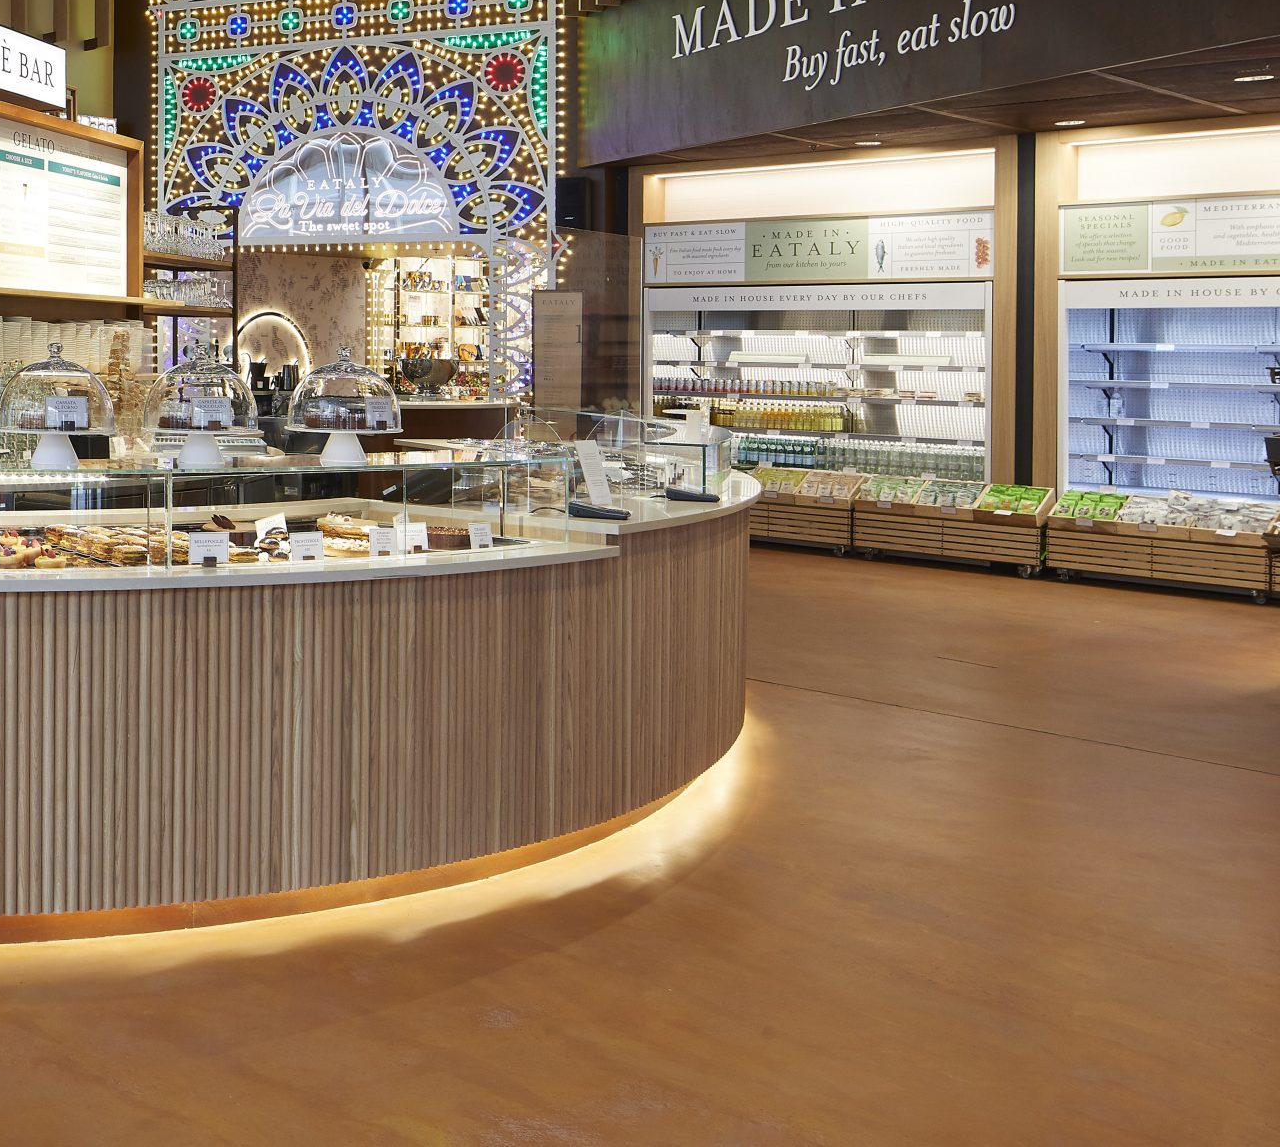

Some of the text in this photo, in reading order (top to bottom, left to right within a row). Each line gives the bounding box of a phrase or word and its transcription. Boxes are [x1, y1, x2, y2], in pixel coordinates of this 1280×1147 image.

[782, 44, 828, 90] Buy
[830, 29, 887, 87] fast,
[896, 13, 941, 55] eat
[18, 51, 55, 88] BAR
[13, 131, 55, 155] GELATO
[306, 177, 383, 191] EATALY
[252, 189, 443, 229] La Via del Dolce
[956, 216, 984, 224] FOOD
[1078, 213, 1136, 223] SEASONAL
[298, 220, 391, 234] The sweet spot
[1080, 222, 1133, 231] SPECIALS
[772, 228, 840, 240] MADE IN
[751, 240, 860, 259] EATALY
[766, 260, 782, 270] from
[795, 260, 819, 268] kitchen
[827, 260, 847, 270] yours
[1190, 259, 1225, 267] MADE
[900, 265, 935, 273] FRESHLY
[692, 295, 721, 303] MADE
[724, 294, 736, 303] IN
[740, 294, 775, 302] HOUSE
[779, 294, 813, 302] EVERY
[861, 293, 885, 301] OUR
[889, 293, 928, 301] CHEFS
[1119, 289, 1160, 298] MADE
[1166, 289, 1183, 297] IN
[1190, 288, 1242, 297] HOUSE
[1250, 288, 1268, 296] BY
